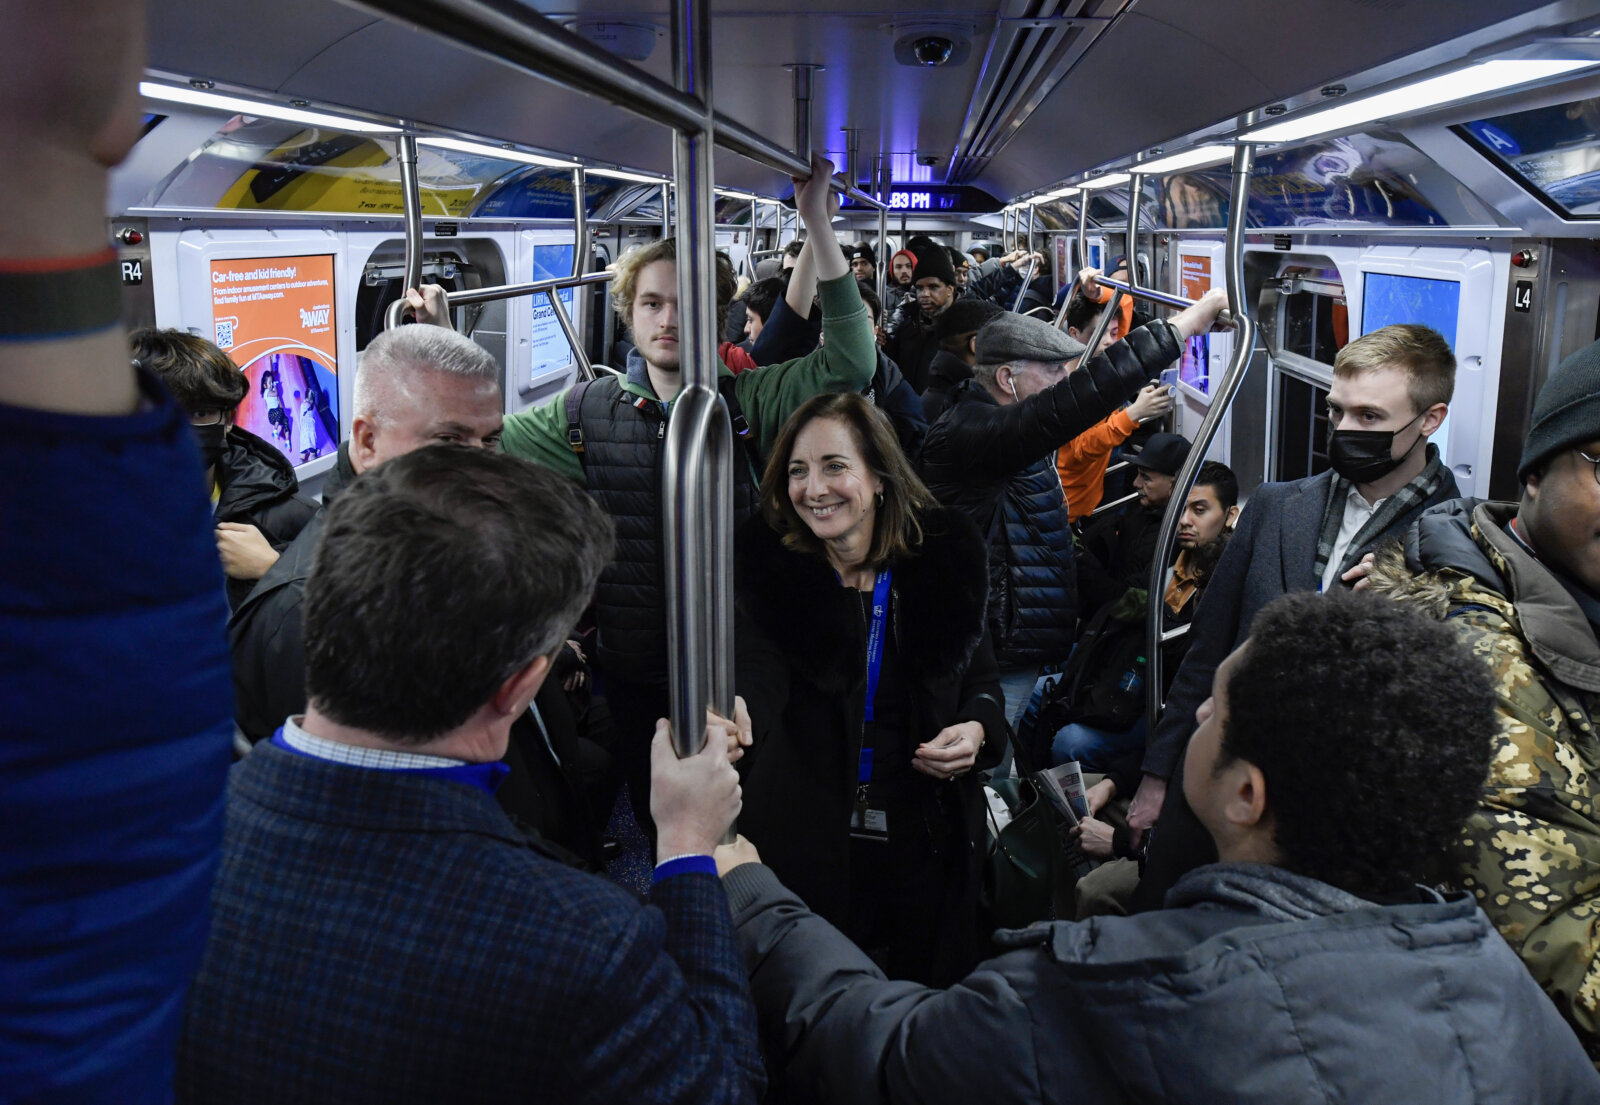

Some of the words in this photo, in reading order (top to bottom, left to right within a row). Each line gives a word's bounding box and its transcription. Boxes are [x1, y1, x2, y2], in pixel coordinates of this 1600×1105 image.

[1481, 128, 1513, 150] A
[911, 192, 930, 209] PM
[121, 262, 142, 281] R4
[212, 270, 244, 283] Car-free
[244, 269, 258, 280] and
[258, 268, 270, 279] kid
[269, 266, 297, 279] friendly!
[213, 287, 227, 296] From
[227, 286, 243, 294] indoor
[1515, 287, 1531, 308] L4
[214, 296, 224, 305] find
[224, 295, 239, 304] family
[301, 309, 331, 328] AWAY
[532, 308, 547, 320] Grand
